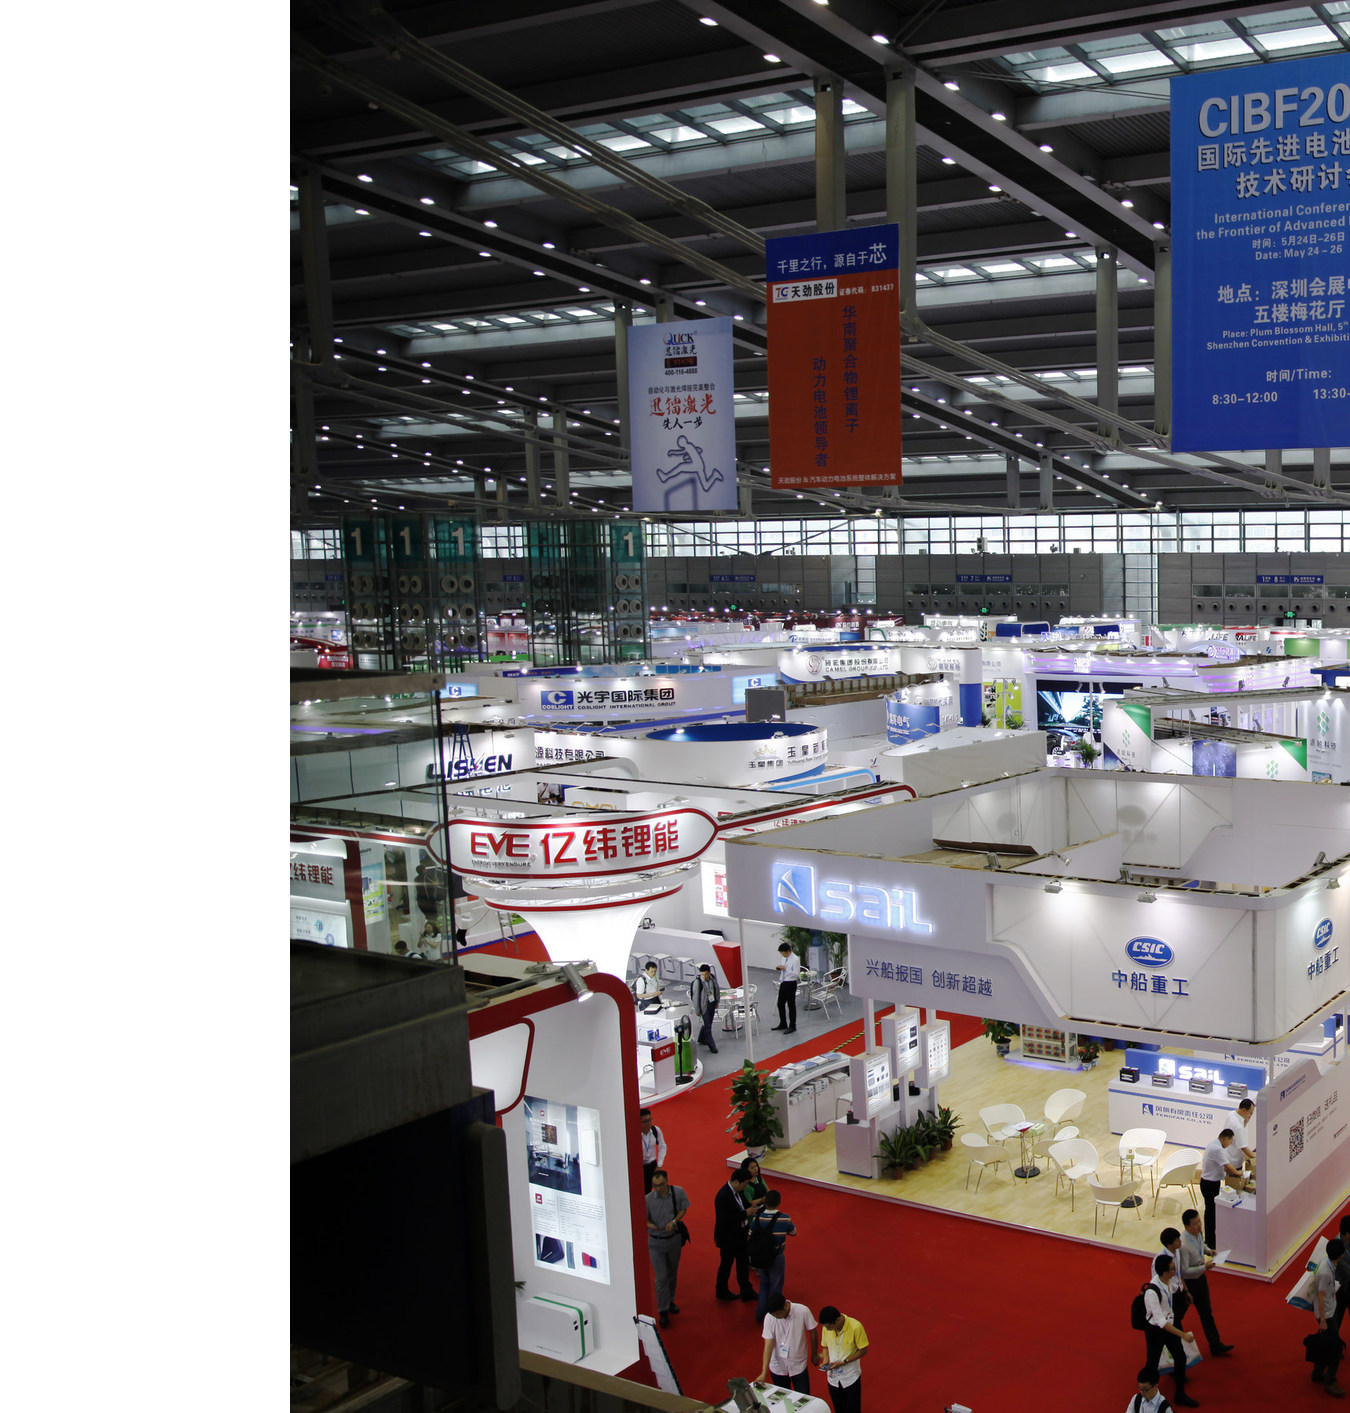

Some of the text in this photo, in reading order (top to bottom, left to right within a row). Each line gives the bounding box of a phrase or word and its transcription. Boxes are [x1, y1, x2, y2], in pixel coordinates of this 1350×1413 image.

[1196, 228, 1215, 240] the
[1218, 225, 1266, 239] Frontier
[1269, 221, 1281, 232] of
[1284, 215, 1346, 231] Advanced
[1214, 206, 1293, 224] International
[1255, 245, 1342, 260] Date: May 24 26
[791, 281, 835, 299] 天劲股份
[1253, 299, 1346, 324] 五楼梅花厅
[663, 332, 695, 346] QUICK
[1207, 340, 1250, 350] Shenzhen
[1251, 336, 1303, 347] Convention
[1305, 335, 1312, 343] &
[1222, 330, 1248, 339] Place:
[1250, 327, 1272, 336] Plum
[1274, 325, 1313, 335] Blossom
[1315, 322, 1336, 333] Hall,
[812, 357, 829, 468] 动力电池领导者
[351, 527, 362, 555] 1
[400, 527, 411, 555] 1
[451, 527, 465, 555] 1
[623, 531, 634, 557] 1
[577, 687, 675, 704] 光宇国际集团
[470, 829, 531, 858] EVE
[541, 819, 680, 866] 亿纬锂能
[1132, 940, 1165, 957] CSIC
[1307, 946, 1340, 981] 中船重工
[865, 957, 993, 997] 兴船报国 创新超越
[1111, 969, 1190, 998] 中船重工
